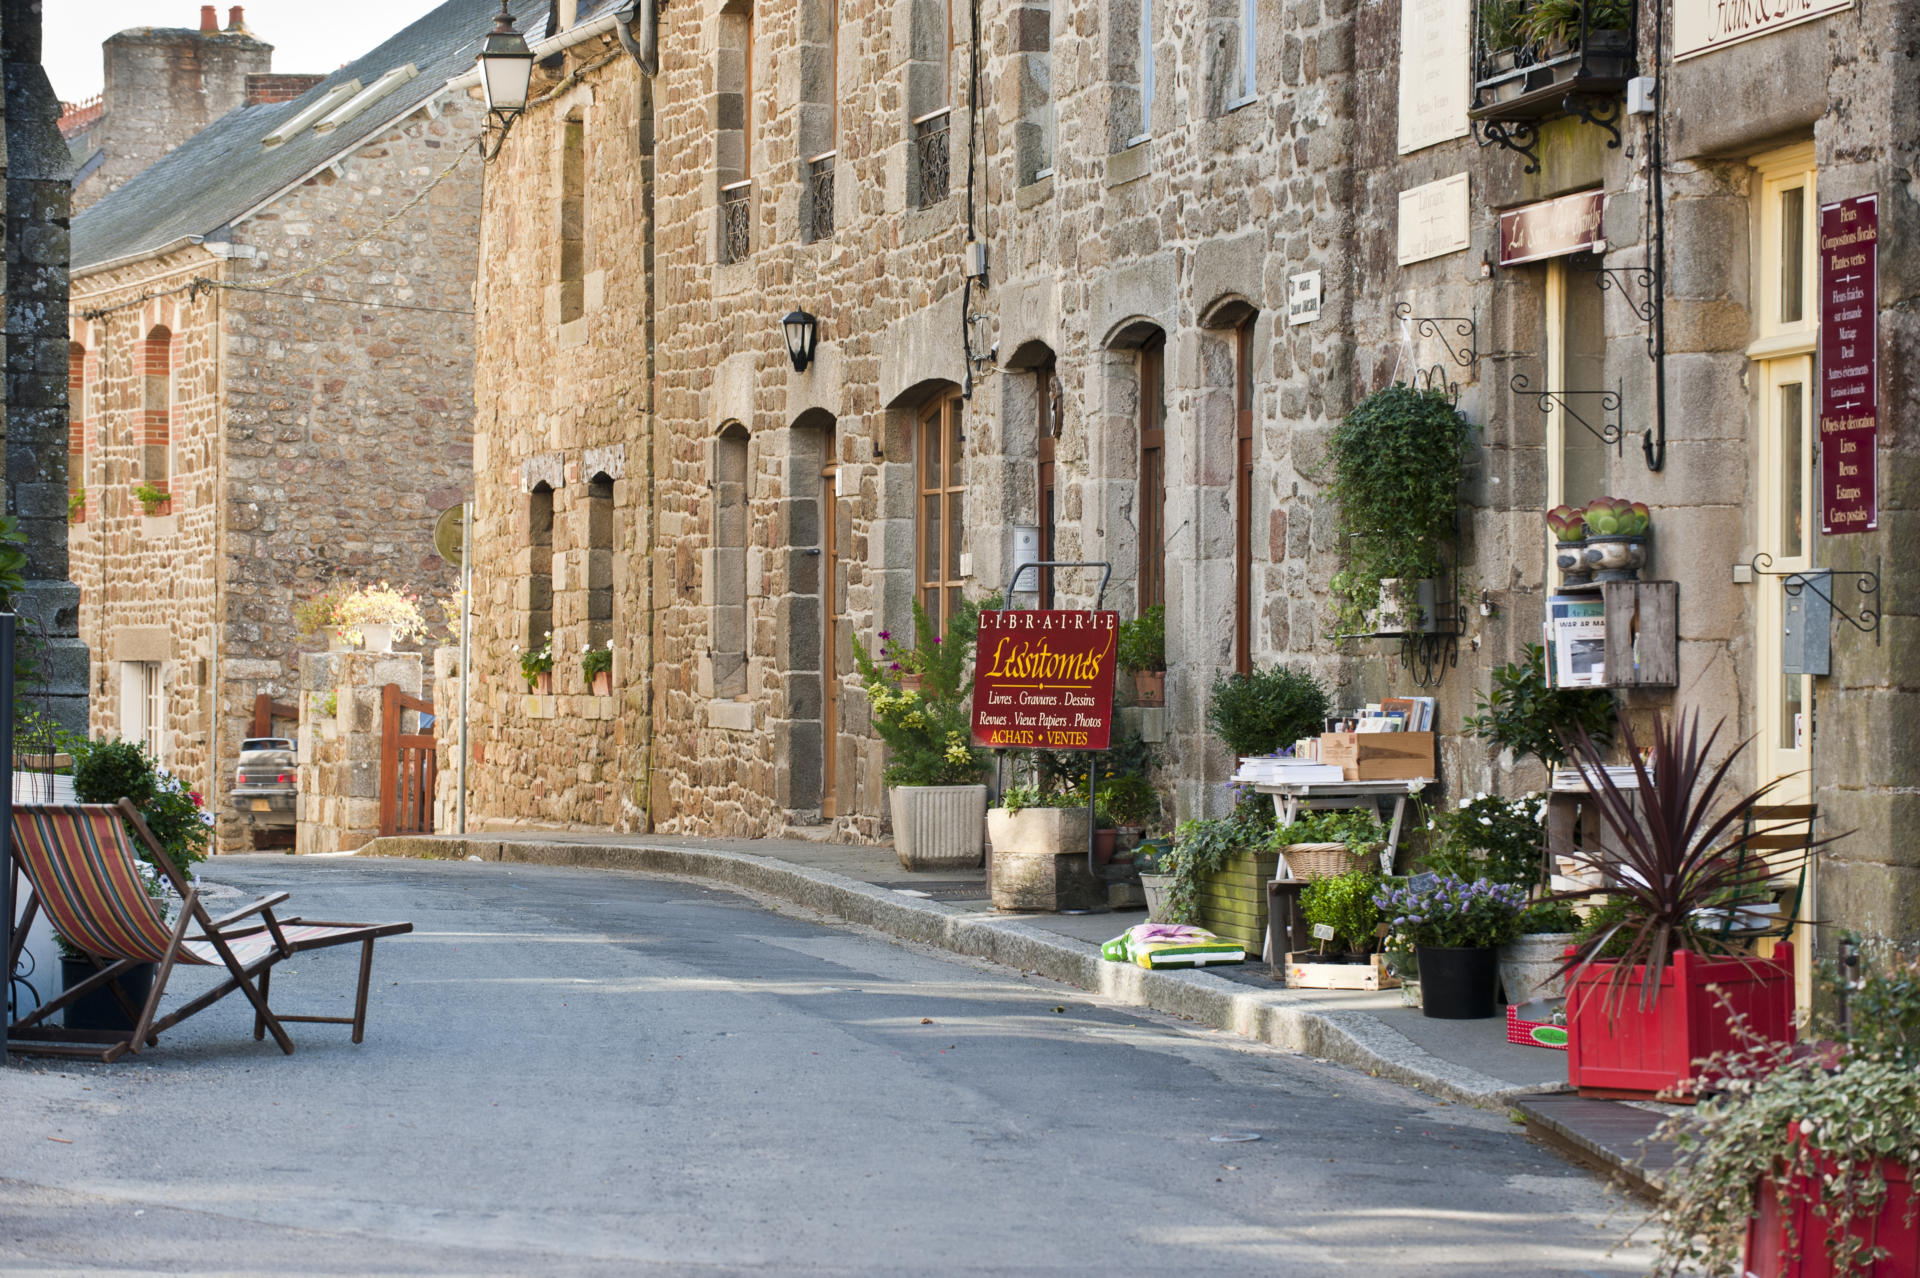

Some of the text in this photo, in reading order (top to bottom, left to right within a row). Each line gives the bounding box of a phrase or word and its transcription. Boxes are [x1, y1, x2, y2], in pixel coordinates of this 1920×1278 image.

[1840, 206, 1857, 223] Fleurs
[988, 690, 1095, 707] Livres Gravures Dessins
[979, 711, 1102, 730] Revues Vieux Papiers Photos
[990, 730, 1088, 746] ACHATS VENTES
